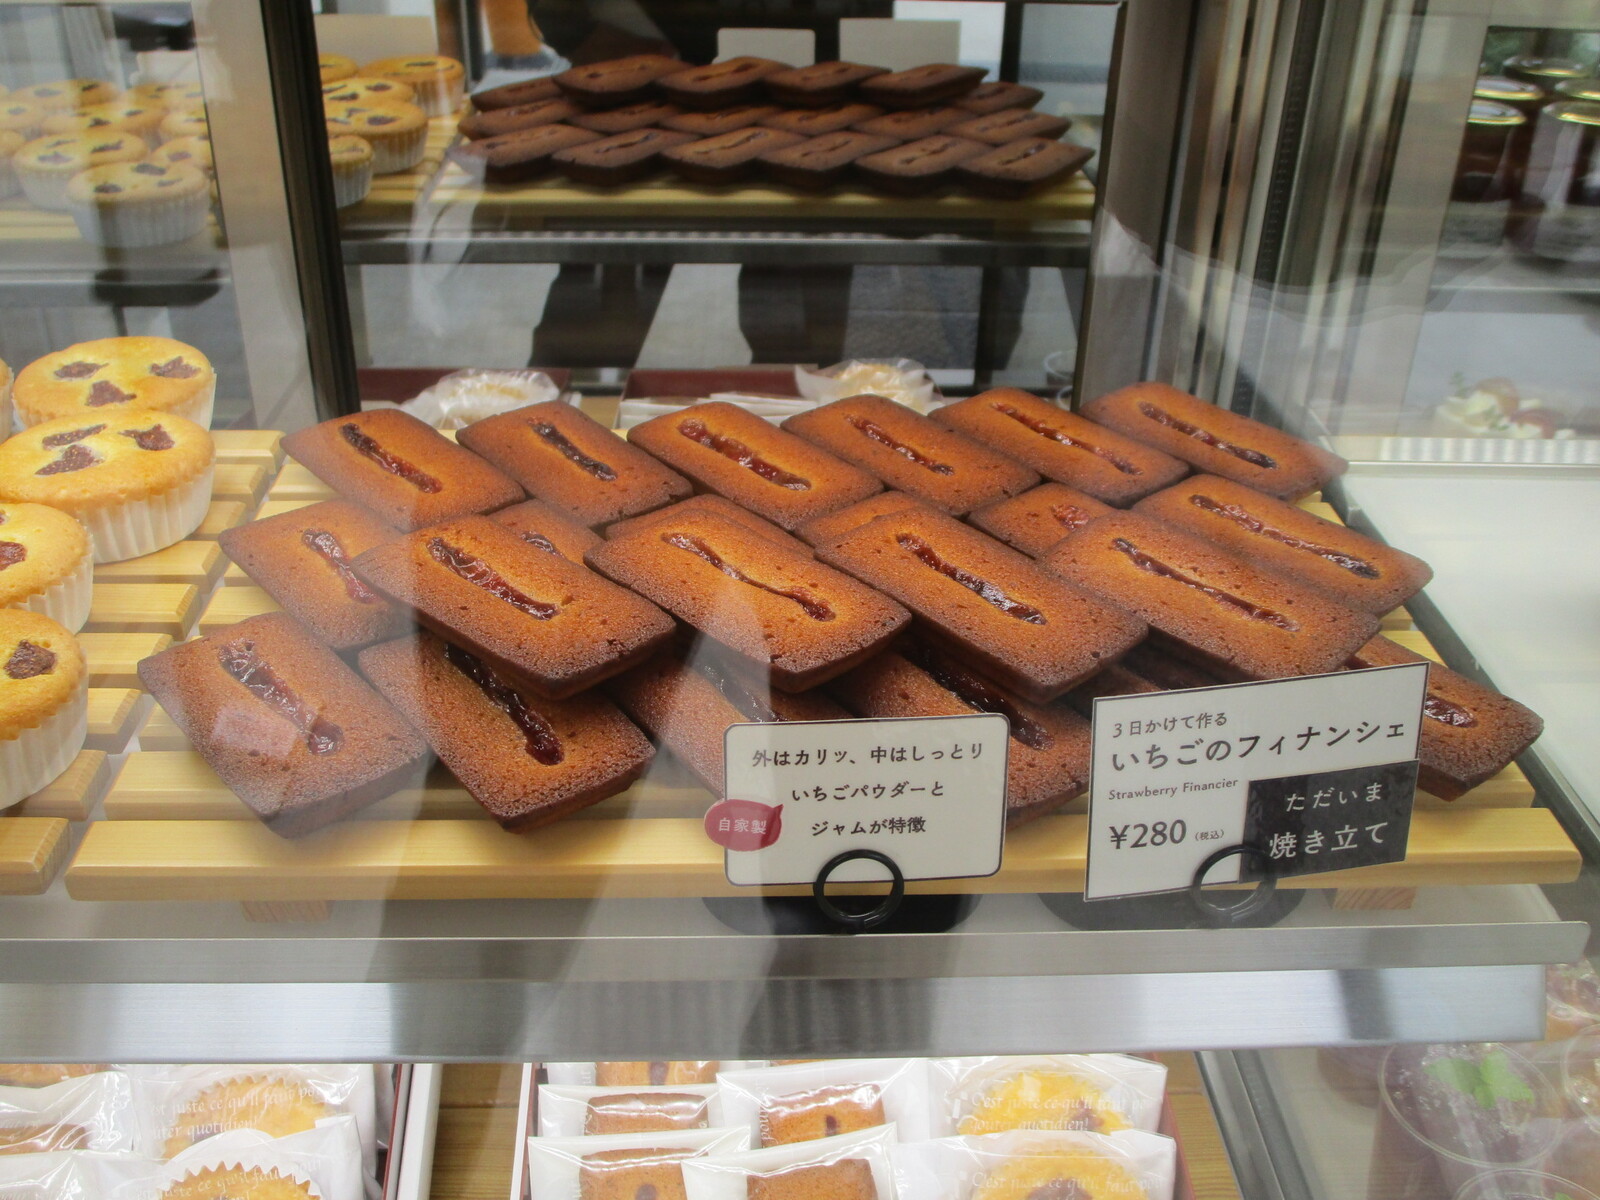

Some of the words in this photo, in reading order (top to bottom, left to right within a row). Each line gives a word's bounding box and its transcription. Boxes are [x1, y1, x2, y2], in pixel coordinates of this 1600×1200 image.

[1112, 712, 1228, 738] 3日かけて作る
[1112, 720, 1406, 772] いちごのフィナンシェ
[792, 781, 945, 802] いちごパウダーと
[1109, 786, 1178, 800] Strawberry
[1183, 778, 1239, 793] Financier
[1286, 782, 1384, 813] ただいま
[718, 817, 768, 835] 自家製
[811, 816, 927, 837] ジャムが特徴
[1109, 819, 1187, 850] ¥280
[1269, 821, 1389, 860] 焼き立て
